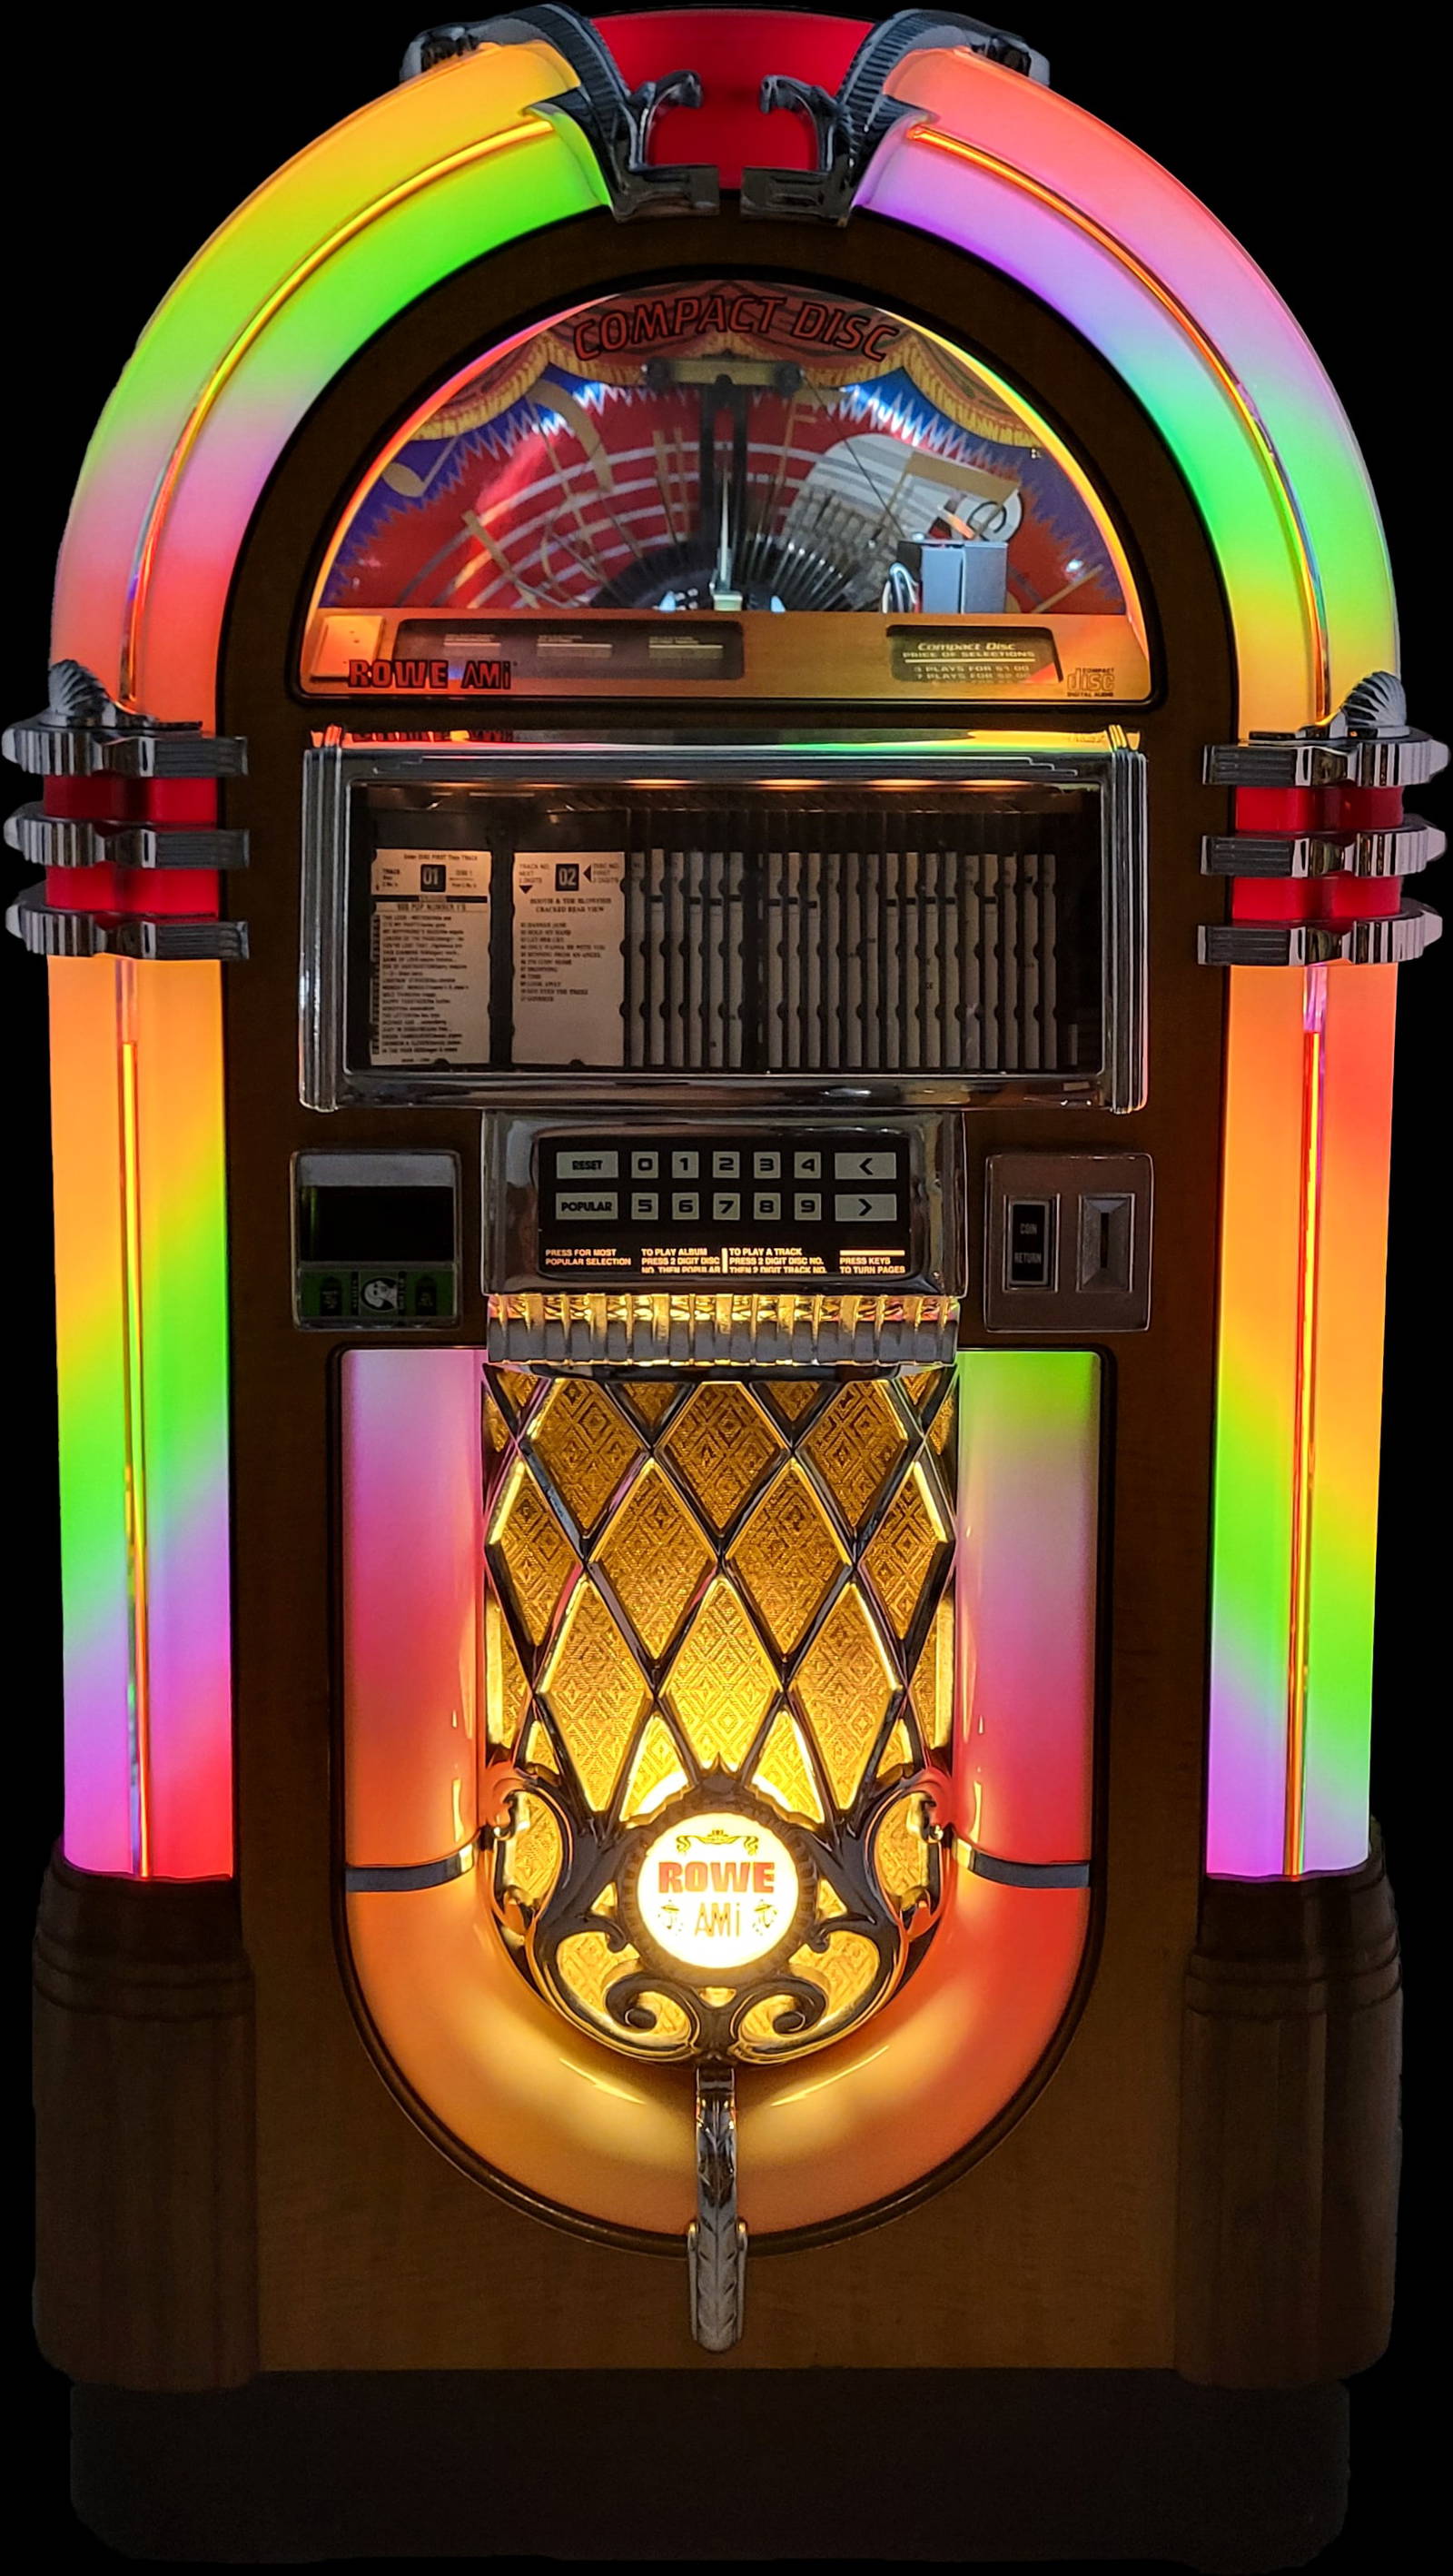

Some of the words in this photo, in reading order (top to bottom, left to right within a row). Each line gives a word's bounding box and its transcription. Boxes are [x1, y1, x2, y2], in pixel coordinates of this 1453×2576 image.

[573, 293, 787, 362] COMPACT
[791, 301, 899, 362] DISC
[917, 643, 980, 651] Compact
[986, 643, 1015, 651] Disc
[349, 659, 450, 689] ROWE
[422, 867, 439, 885] 01
[558, 868, 576, 887] 02
[572, 1160, 603, 1171] RESET
[638, 1158, 652, 1171] 0
[679, 1157, 688, 1171] 1
[719, 1157, 734, 1171] 2
[760, 1158, 774, 1171] 3
[801, 1158, 815, 1172] 4
[561, 1201, 612, 1212] POPULAR
[638, 1199, 652, 1213] 5
[678, 1200, 693, 1213] 6
[719, 1200, 734, 1214] 7
[759, 1200, 774, 1213] 8
[800, 1200, 815, 1213] 9
[1020, 1223, 1037, 1234] COIN
[545, 1249, 572, 1257] PRESS
[574, 1249, 591, 1257] FOR
[593, 1249, 617, 1257] MOST
[641, 1248, 653, 1256] TO
[655, 1248, 676, 1256] PLAY
[678, 1248, 707, 1256] ALBUM
[729, 1248, 741, 1256] TO
[743, 1248, 764, 1256] PLAY
[766, 1248, 772, 1256] A
[775, 1248, 802, 1256] TRACK
[545, 1258, 584, 1266] POPULAR
[586, 1258, 631, 1266] SELECTION
[641, 1257, 668, 1265] PRESS
[670, 1257, 676, 1265] 2
[677, 1257, 698, 1265] DIGIT
[700, 1257, 720, 1265] DISC
[729, 1257, 756, 1265] PRESS
[758, 1257, 764, 1265] 2
[766, 1257, 786, 1265] DIGIT
[788, 1257, 807, 1265] DISC
[809, 1257, 824, 1265] NO.
[840, 1257, 866, 1265] PRESS
[869, 1257, 891, 1265] KEYS
[1014, 1253, 1042, 1263] RETURN
[657, 1862, 776, 1894] ROWE
